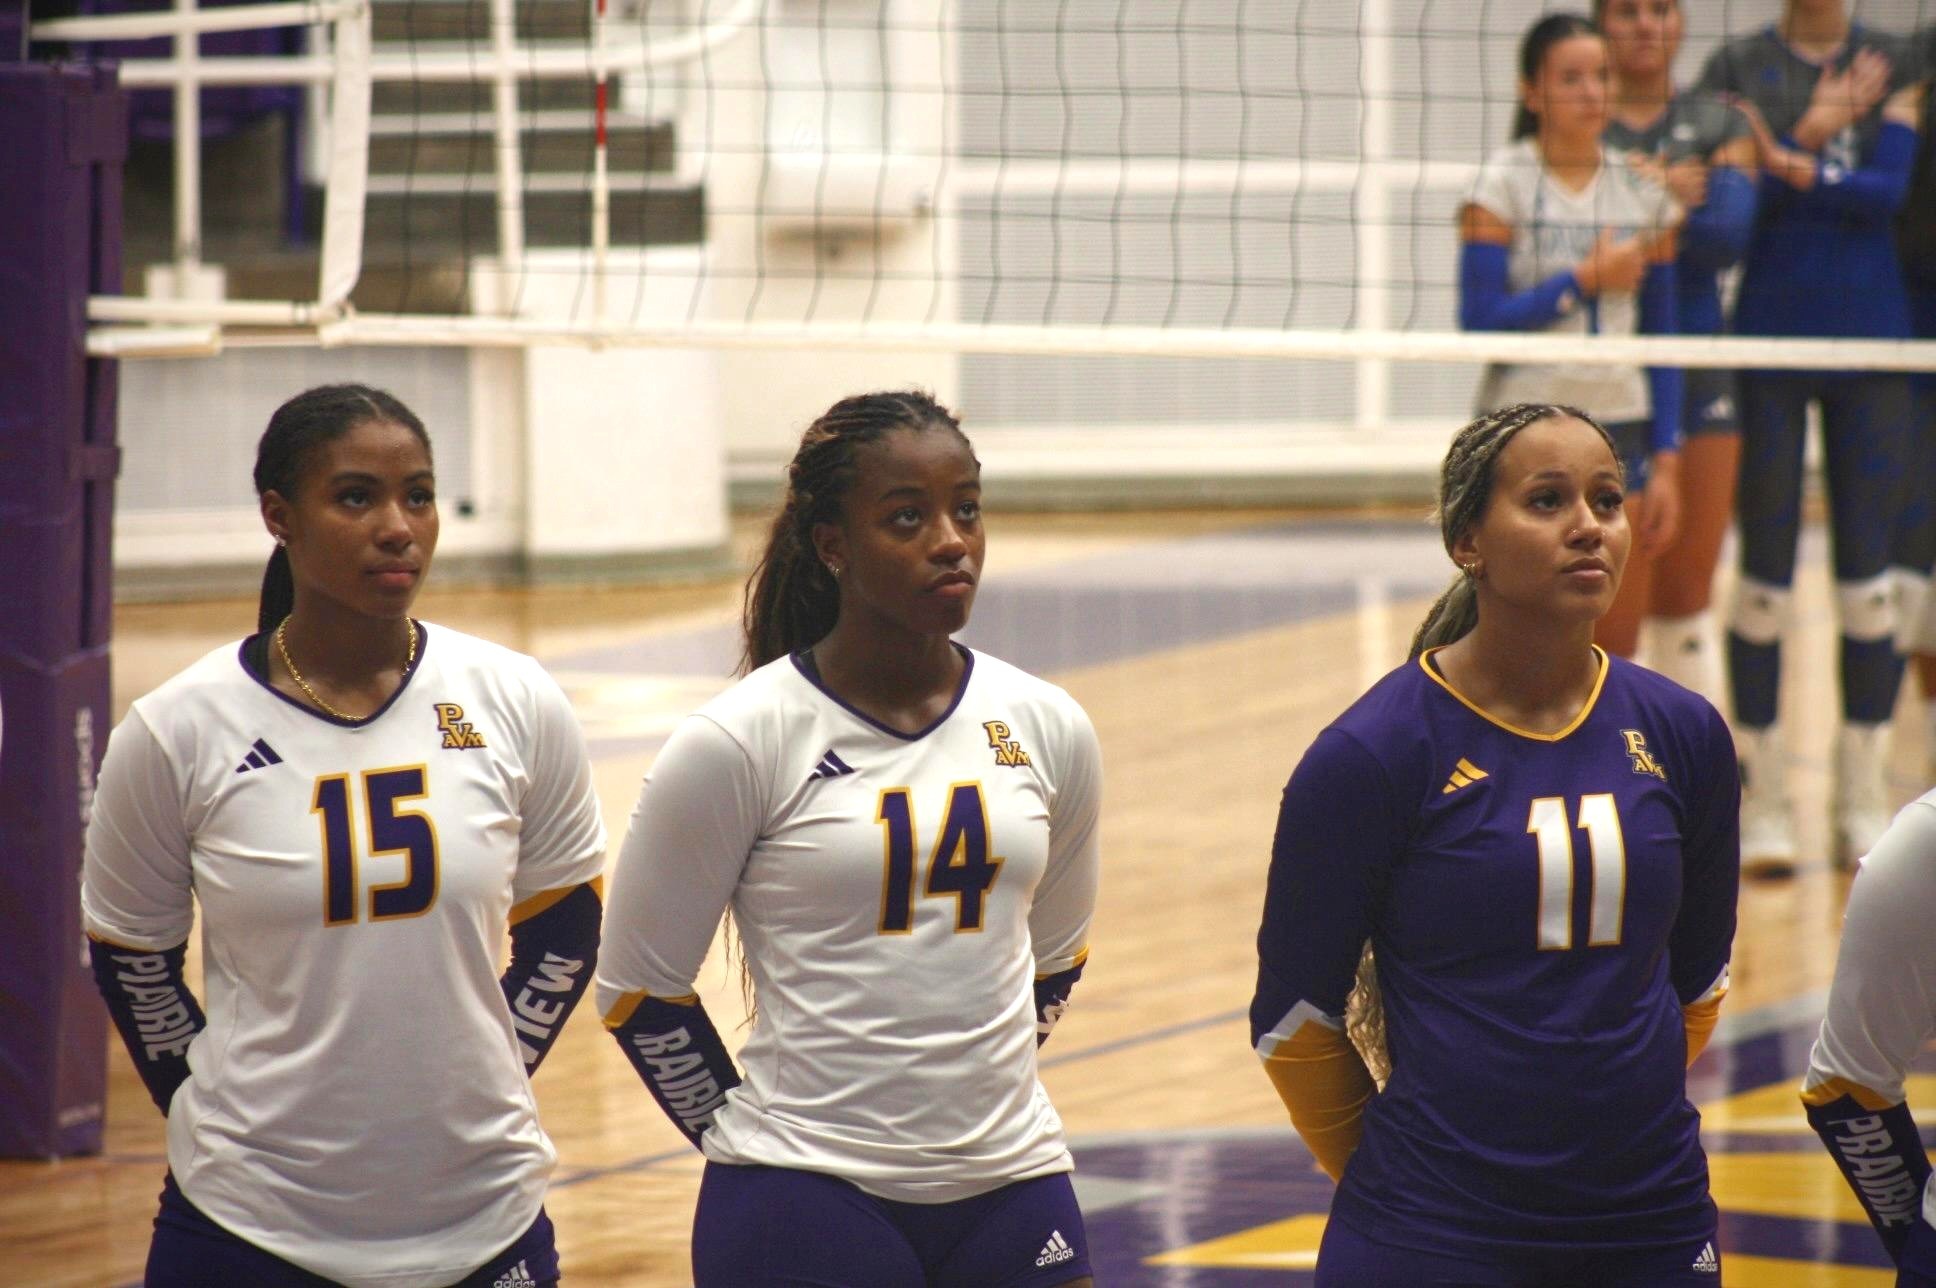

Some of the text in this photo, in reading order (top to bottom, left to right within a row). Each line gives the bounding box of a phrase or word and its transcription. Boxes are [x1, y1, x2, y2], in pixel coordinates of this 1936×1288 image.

[310, 763, 441, 928] 15
[875, 780, 1006, 935] 14
[1527, 793, 1627, 950] 11
[633, 1026, 727, 1133] RAIRIE
[1036, 1247, 1074, 1267] adidas
[1692, 1261, 1718, 1272] adida
